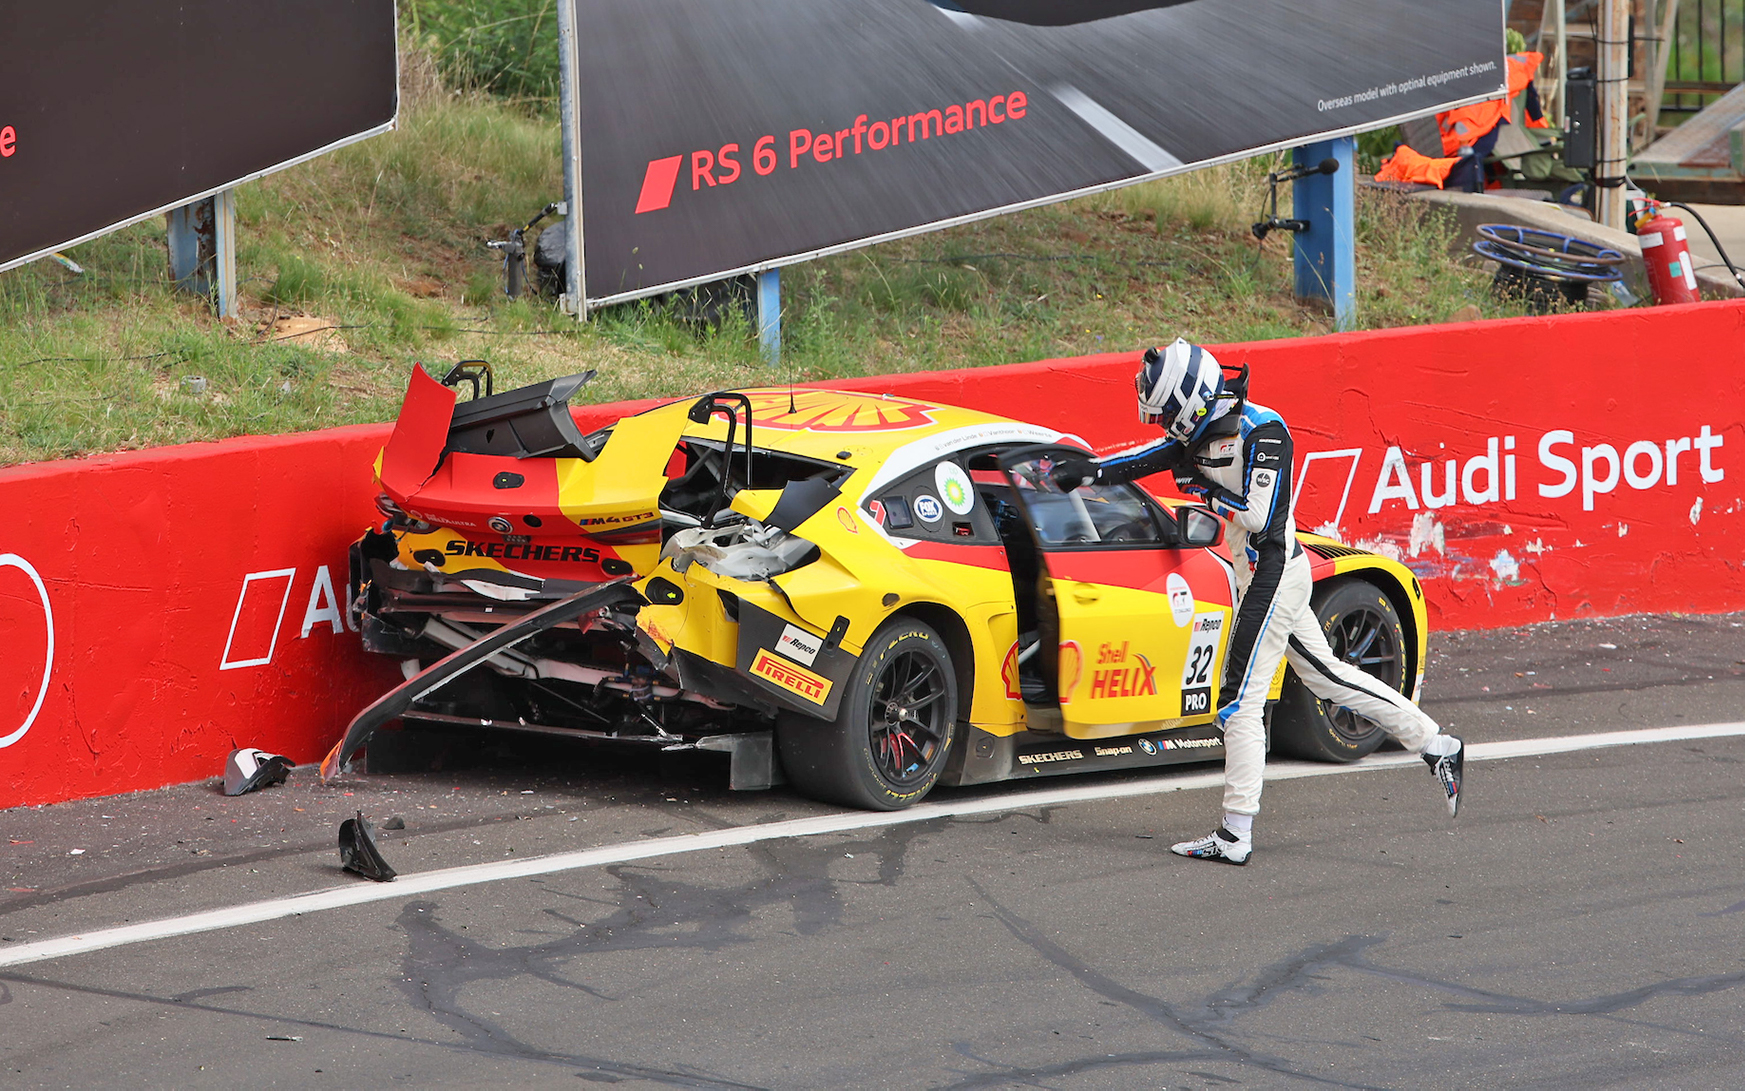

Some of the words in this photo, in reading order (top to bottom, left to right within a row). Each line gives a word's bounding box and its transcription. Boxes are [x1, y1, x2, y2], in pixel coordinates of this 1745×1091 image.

[1318, 95, 1353, 112] Overseas
[1353, 87, 1379, 104] model
[1379, 82, 1398, 97] with
[1398, 75, 1426, 95] optinal
[1427, 66, 1469, 87] equipment
[1469, 61, 1498, 75] shown.
[691, 143, 741, 191] RS
[752, 135, 778, 176] 6
[789, 90, 1028, 169] Performance
[1367, 435, 1516, 514] Audi
[1538, 424, 1725, 511] Sport
[622, 511, 654, 522] GT3
[444, 540, 601, 564] SKECHERS
[1199, 618, 1222, 633] Repco
[789, 638, 816, 655] Repco
[1097, 641, 1129, 664] Shell
[756, 655, 825, 698] PIRELLI
[1186, 644, 1214, 686] 32
[1090, 655, 1156, 699] HELIX
[1185, 691, 1208, 711] PRO
[1094, 746, 1133, 757] Snap-on
[1174, 736, 1223, 749] Motorsport
[1018, 750, 1084, 765] SKECHERS
